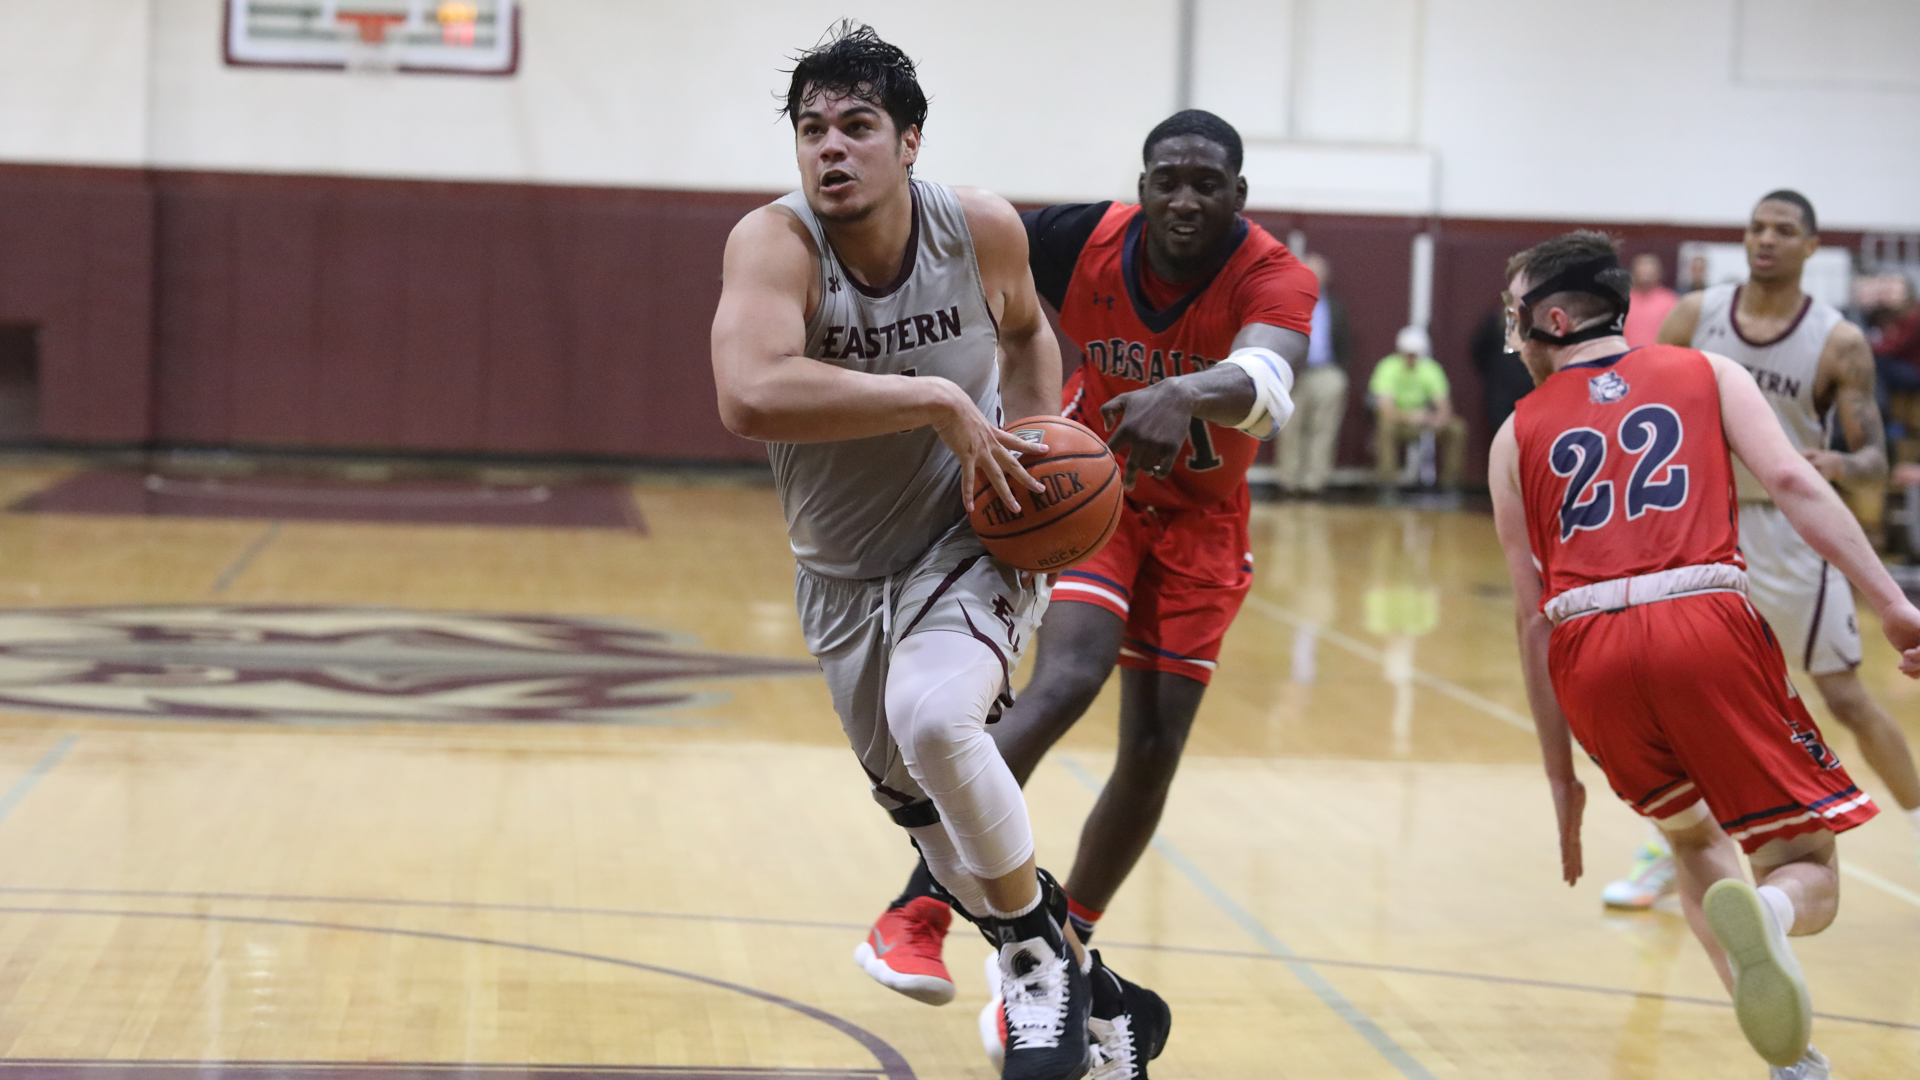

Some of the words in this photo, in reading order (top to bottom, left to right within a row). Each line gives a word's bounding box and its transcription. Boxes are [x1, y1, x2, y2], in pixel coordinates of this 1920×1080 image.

[821, 306, 962, 361] EASTERN
[1086, 338, 1218, 386] DESAL
[1549, 404, 1688, 542] 22
[1037, 547, 1079, 566] ROCK
